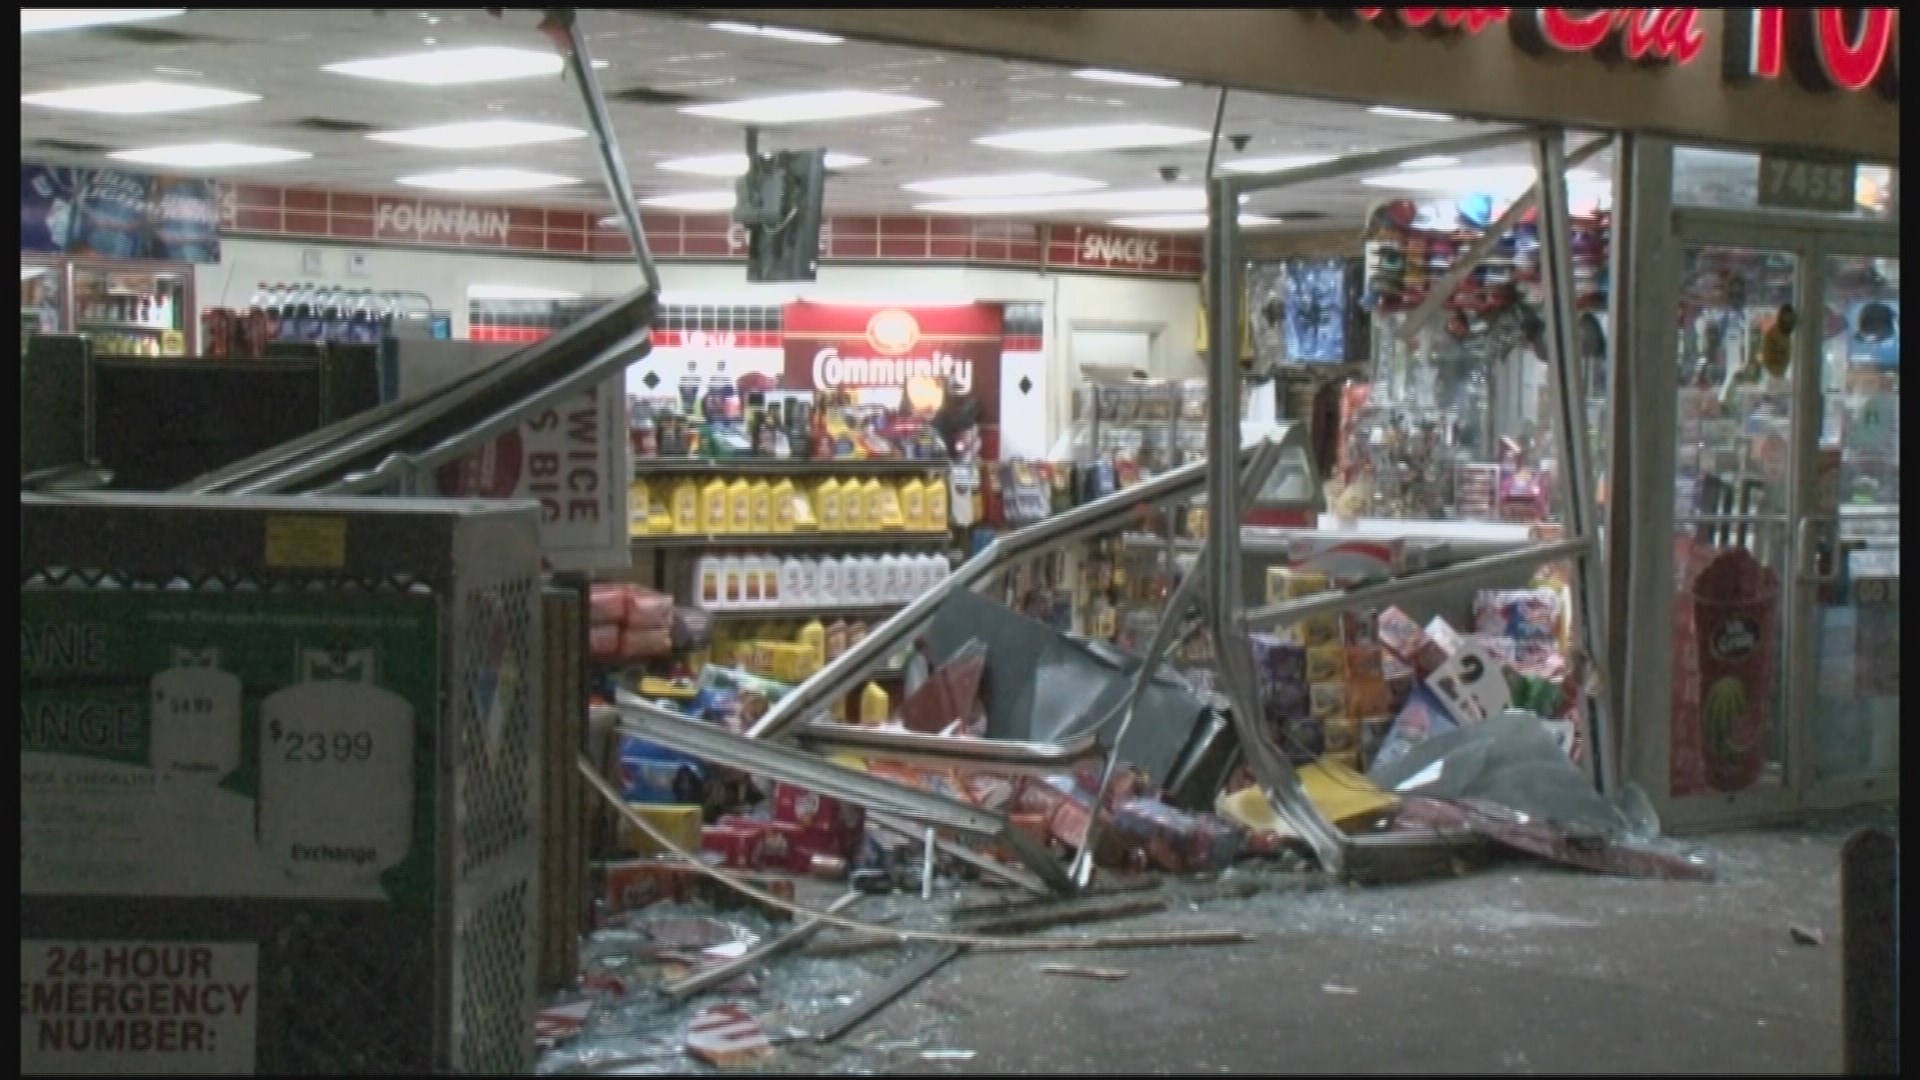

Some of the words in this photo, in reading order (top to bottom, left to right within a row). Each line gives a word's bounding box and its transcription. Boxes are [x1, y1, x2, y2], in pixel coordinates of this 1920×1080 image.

[378, 202, 511, 239] FOUNTAIN
[1083, 234, 1159, 264] SNACKS
[811, 346, 973, 396] Community
[290, 843, 377, 866] Exchange
[46, 946, 213, 978] 24-HOUR
[38, 1018, 217, 1052] NUMBER:
